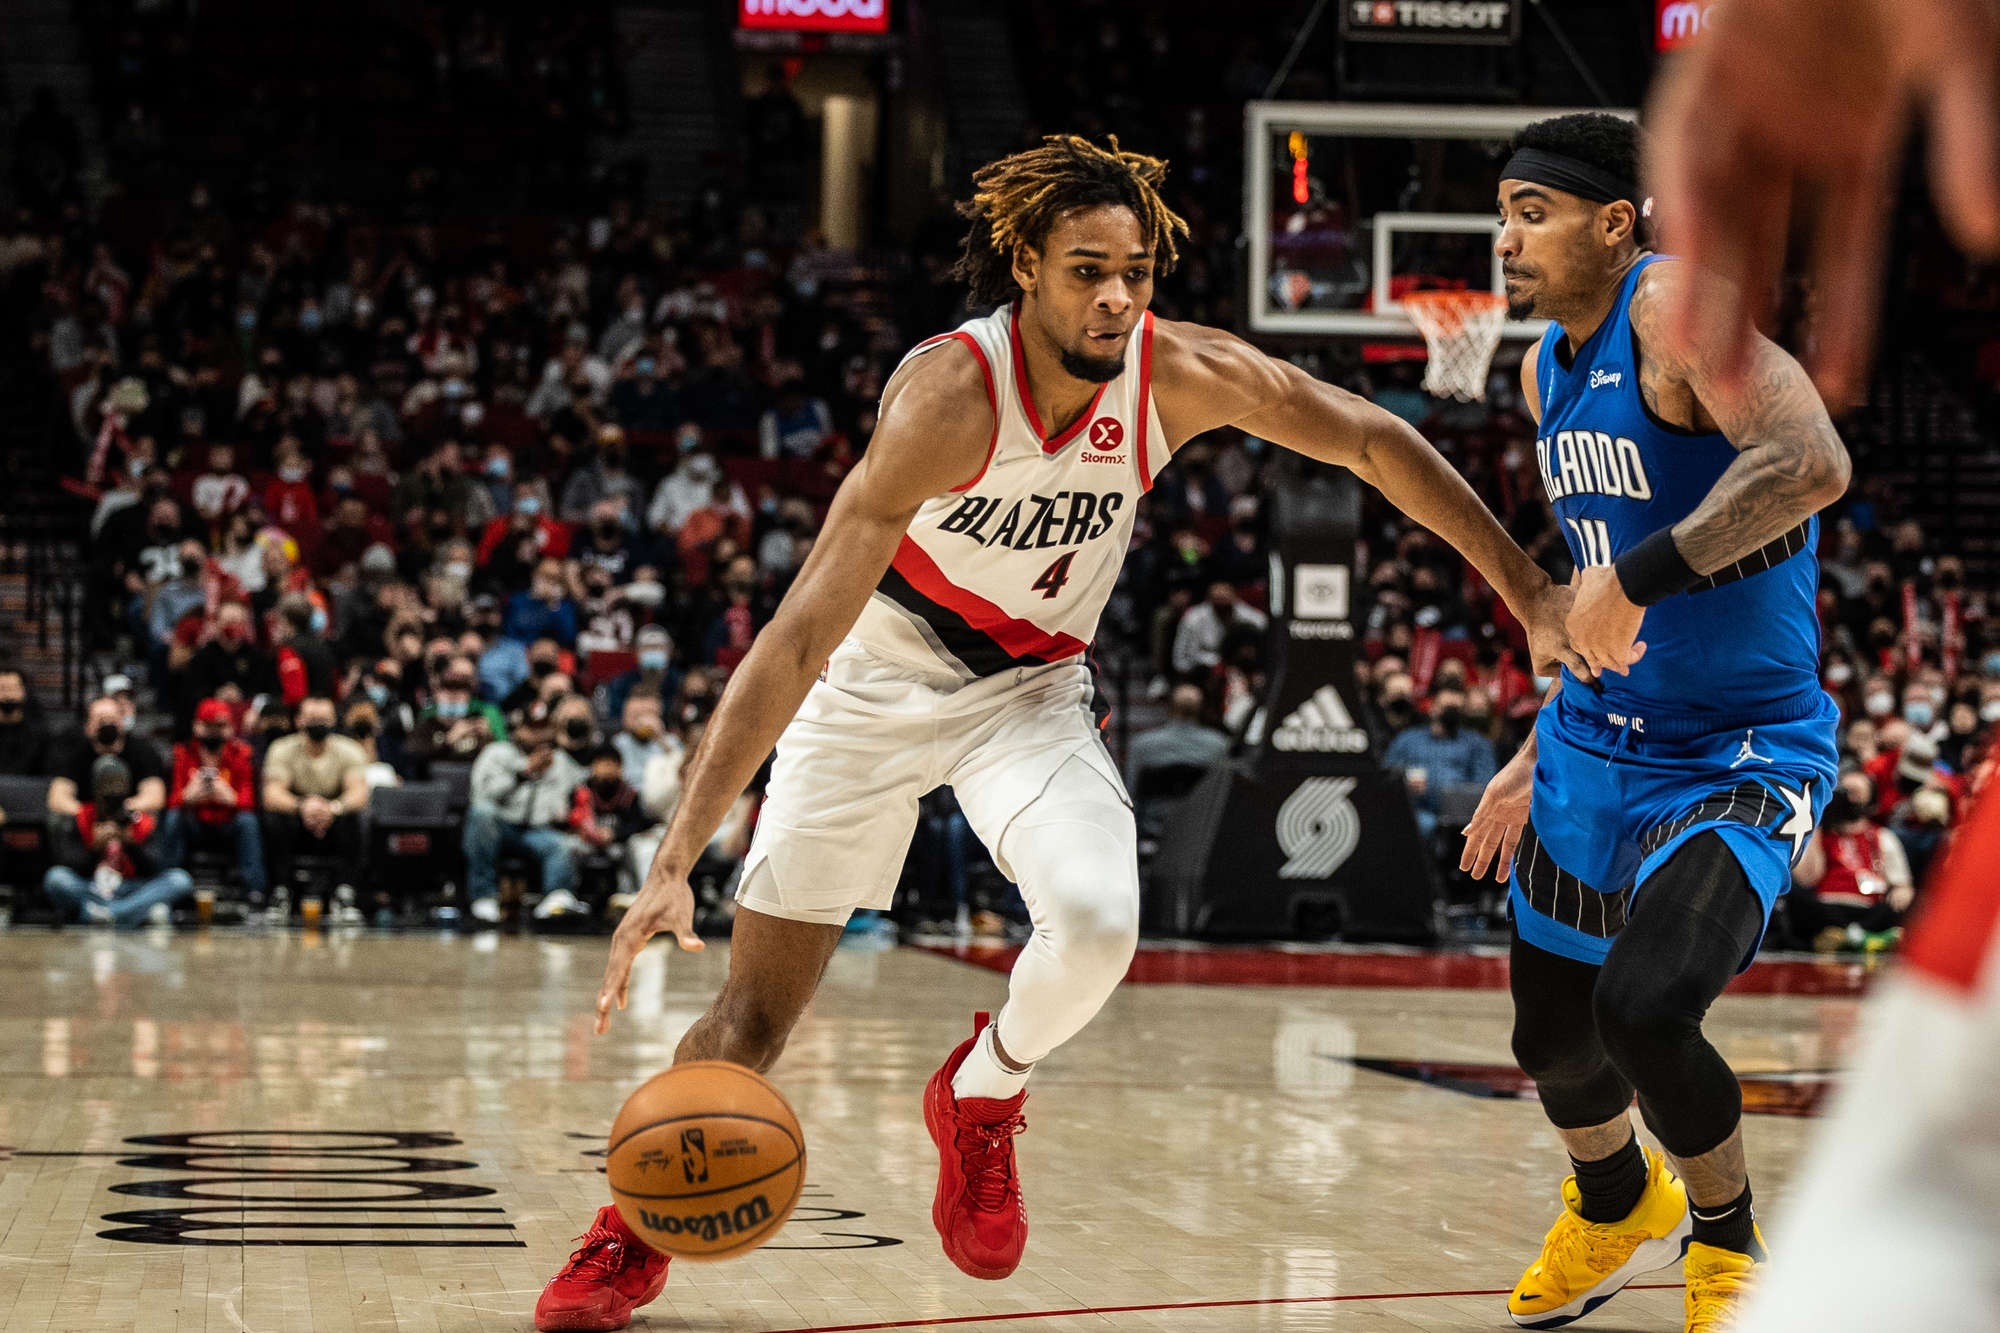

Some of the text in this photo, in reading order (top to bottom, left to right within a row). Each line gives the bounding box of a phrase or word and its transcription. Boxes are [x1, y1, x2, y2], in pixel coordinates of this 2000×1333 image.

[1590, 369, 1621, 389] Disney
[1081, 452, 1127, 465] StormX
[1536, 430, 1652, 503] RLANDO
[937, 491, 1124, 550] BLAZERS
[1031, 549, 1080, 600] 4
[638, 1194, 773, 1242] Wilson
